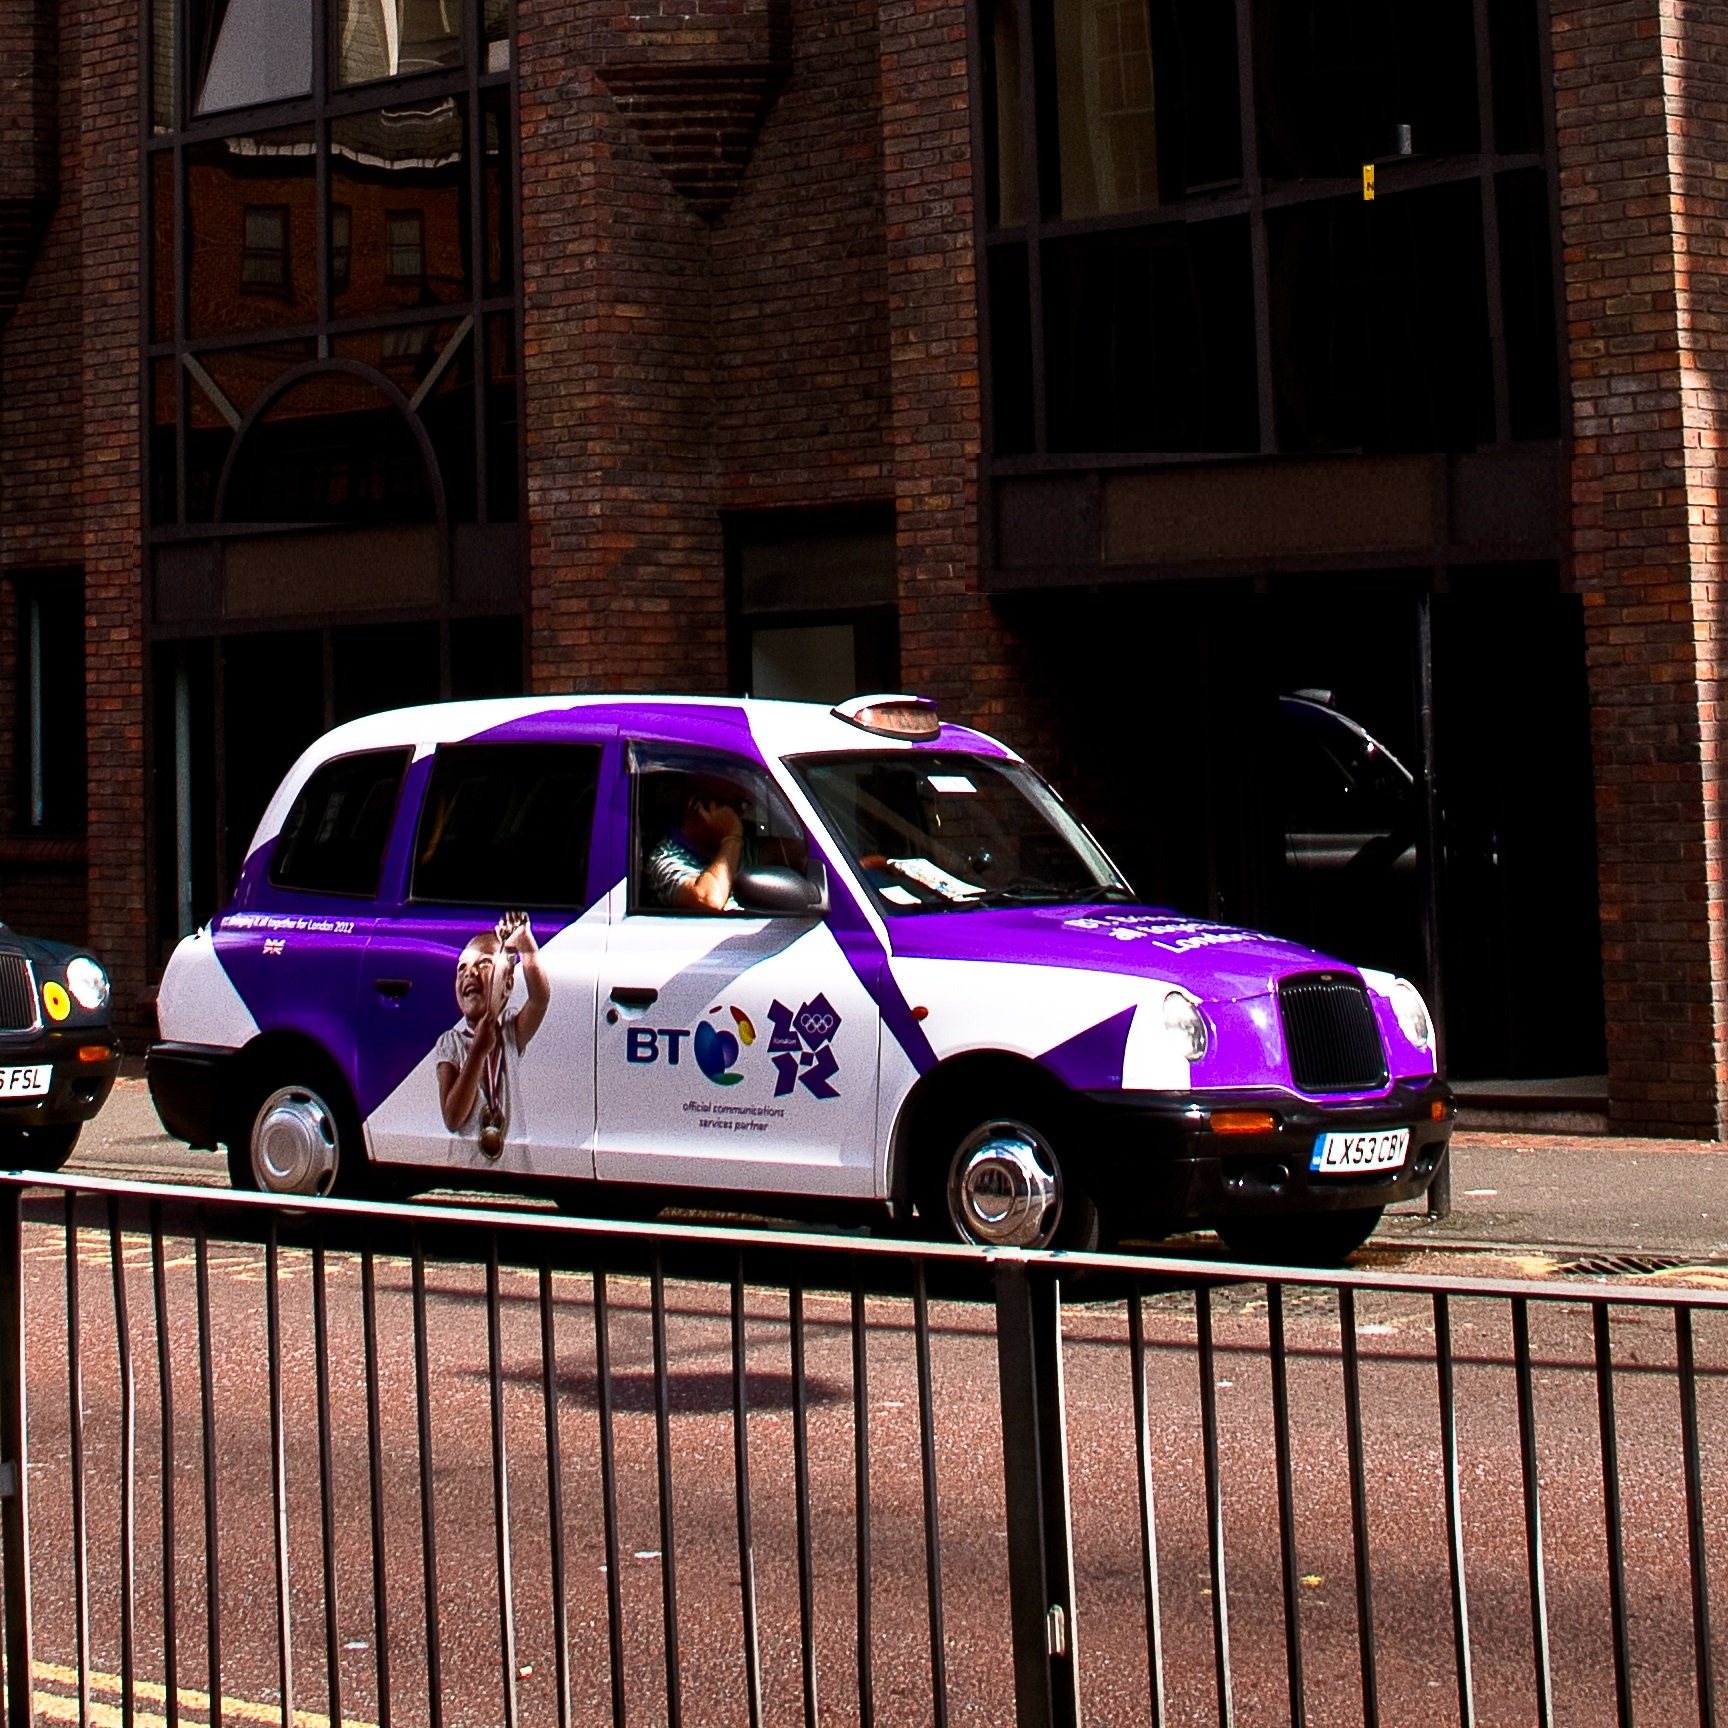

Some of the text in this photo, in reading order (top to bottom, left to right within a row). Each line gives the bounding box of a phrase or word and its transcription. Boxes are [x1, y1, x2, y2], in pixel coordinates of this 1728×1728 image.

[334, 921, 354, 933] 2012
[627, 1027, 691, 1065] BT
[9, 1069, 41, 1090] FSL
[682, 1100, 785, 1118] official communications
[699, 1117, 769, 1132] services partner
[1326, 1131, 1408, 1165] LX53 CBY
